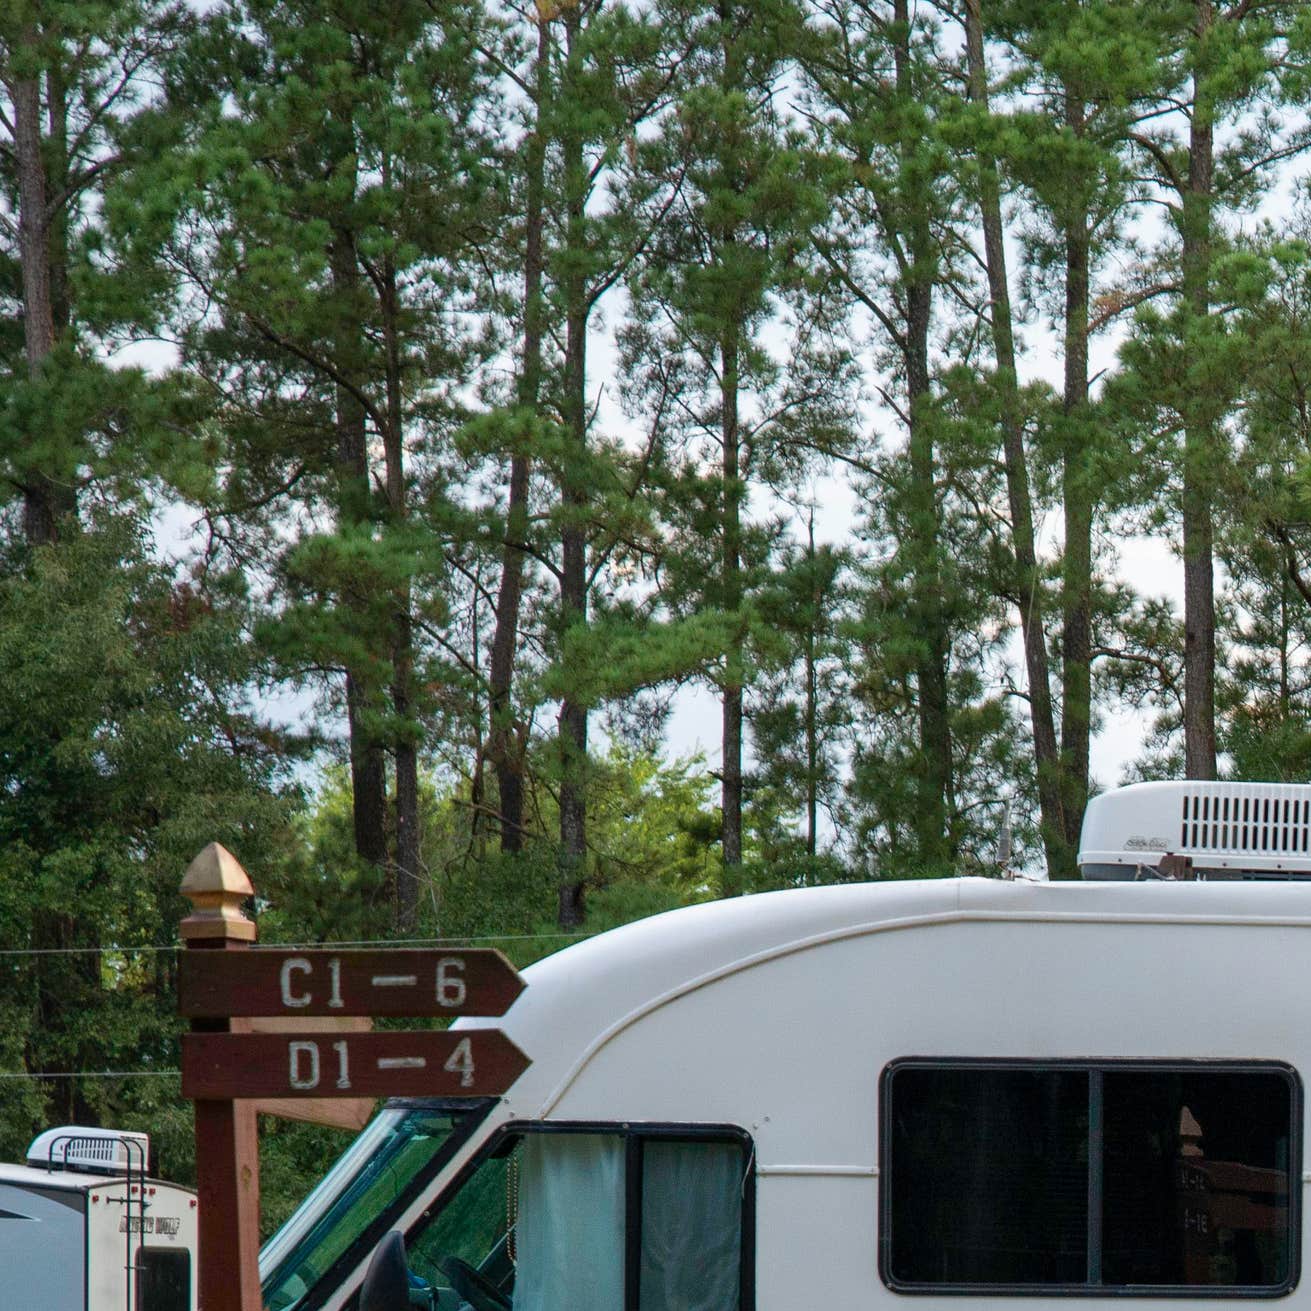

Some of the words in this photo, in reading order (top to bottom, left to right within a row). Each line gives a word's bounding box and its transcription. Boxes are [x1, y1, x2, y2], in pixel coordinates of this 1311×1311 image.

[280, 957, 344, 1008] C1
[435, 957, 466, 1007] 6
[289, 1041, 351, 1089] D1
[444, 1037, 475, 1087] 4
